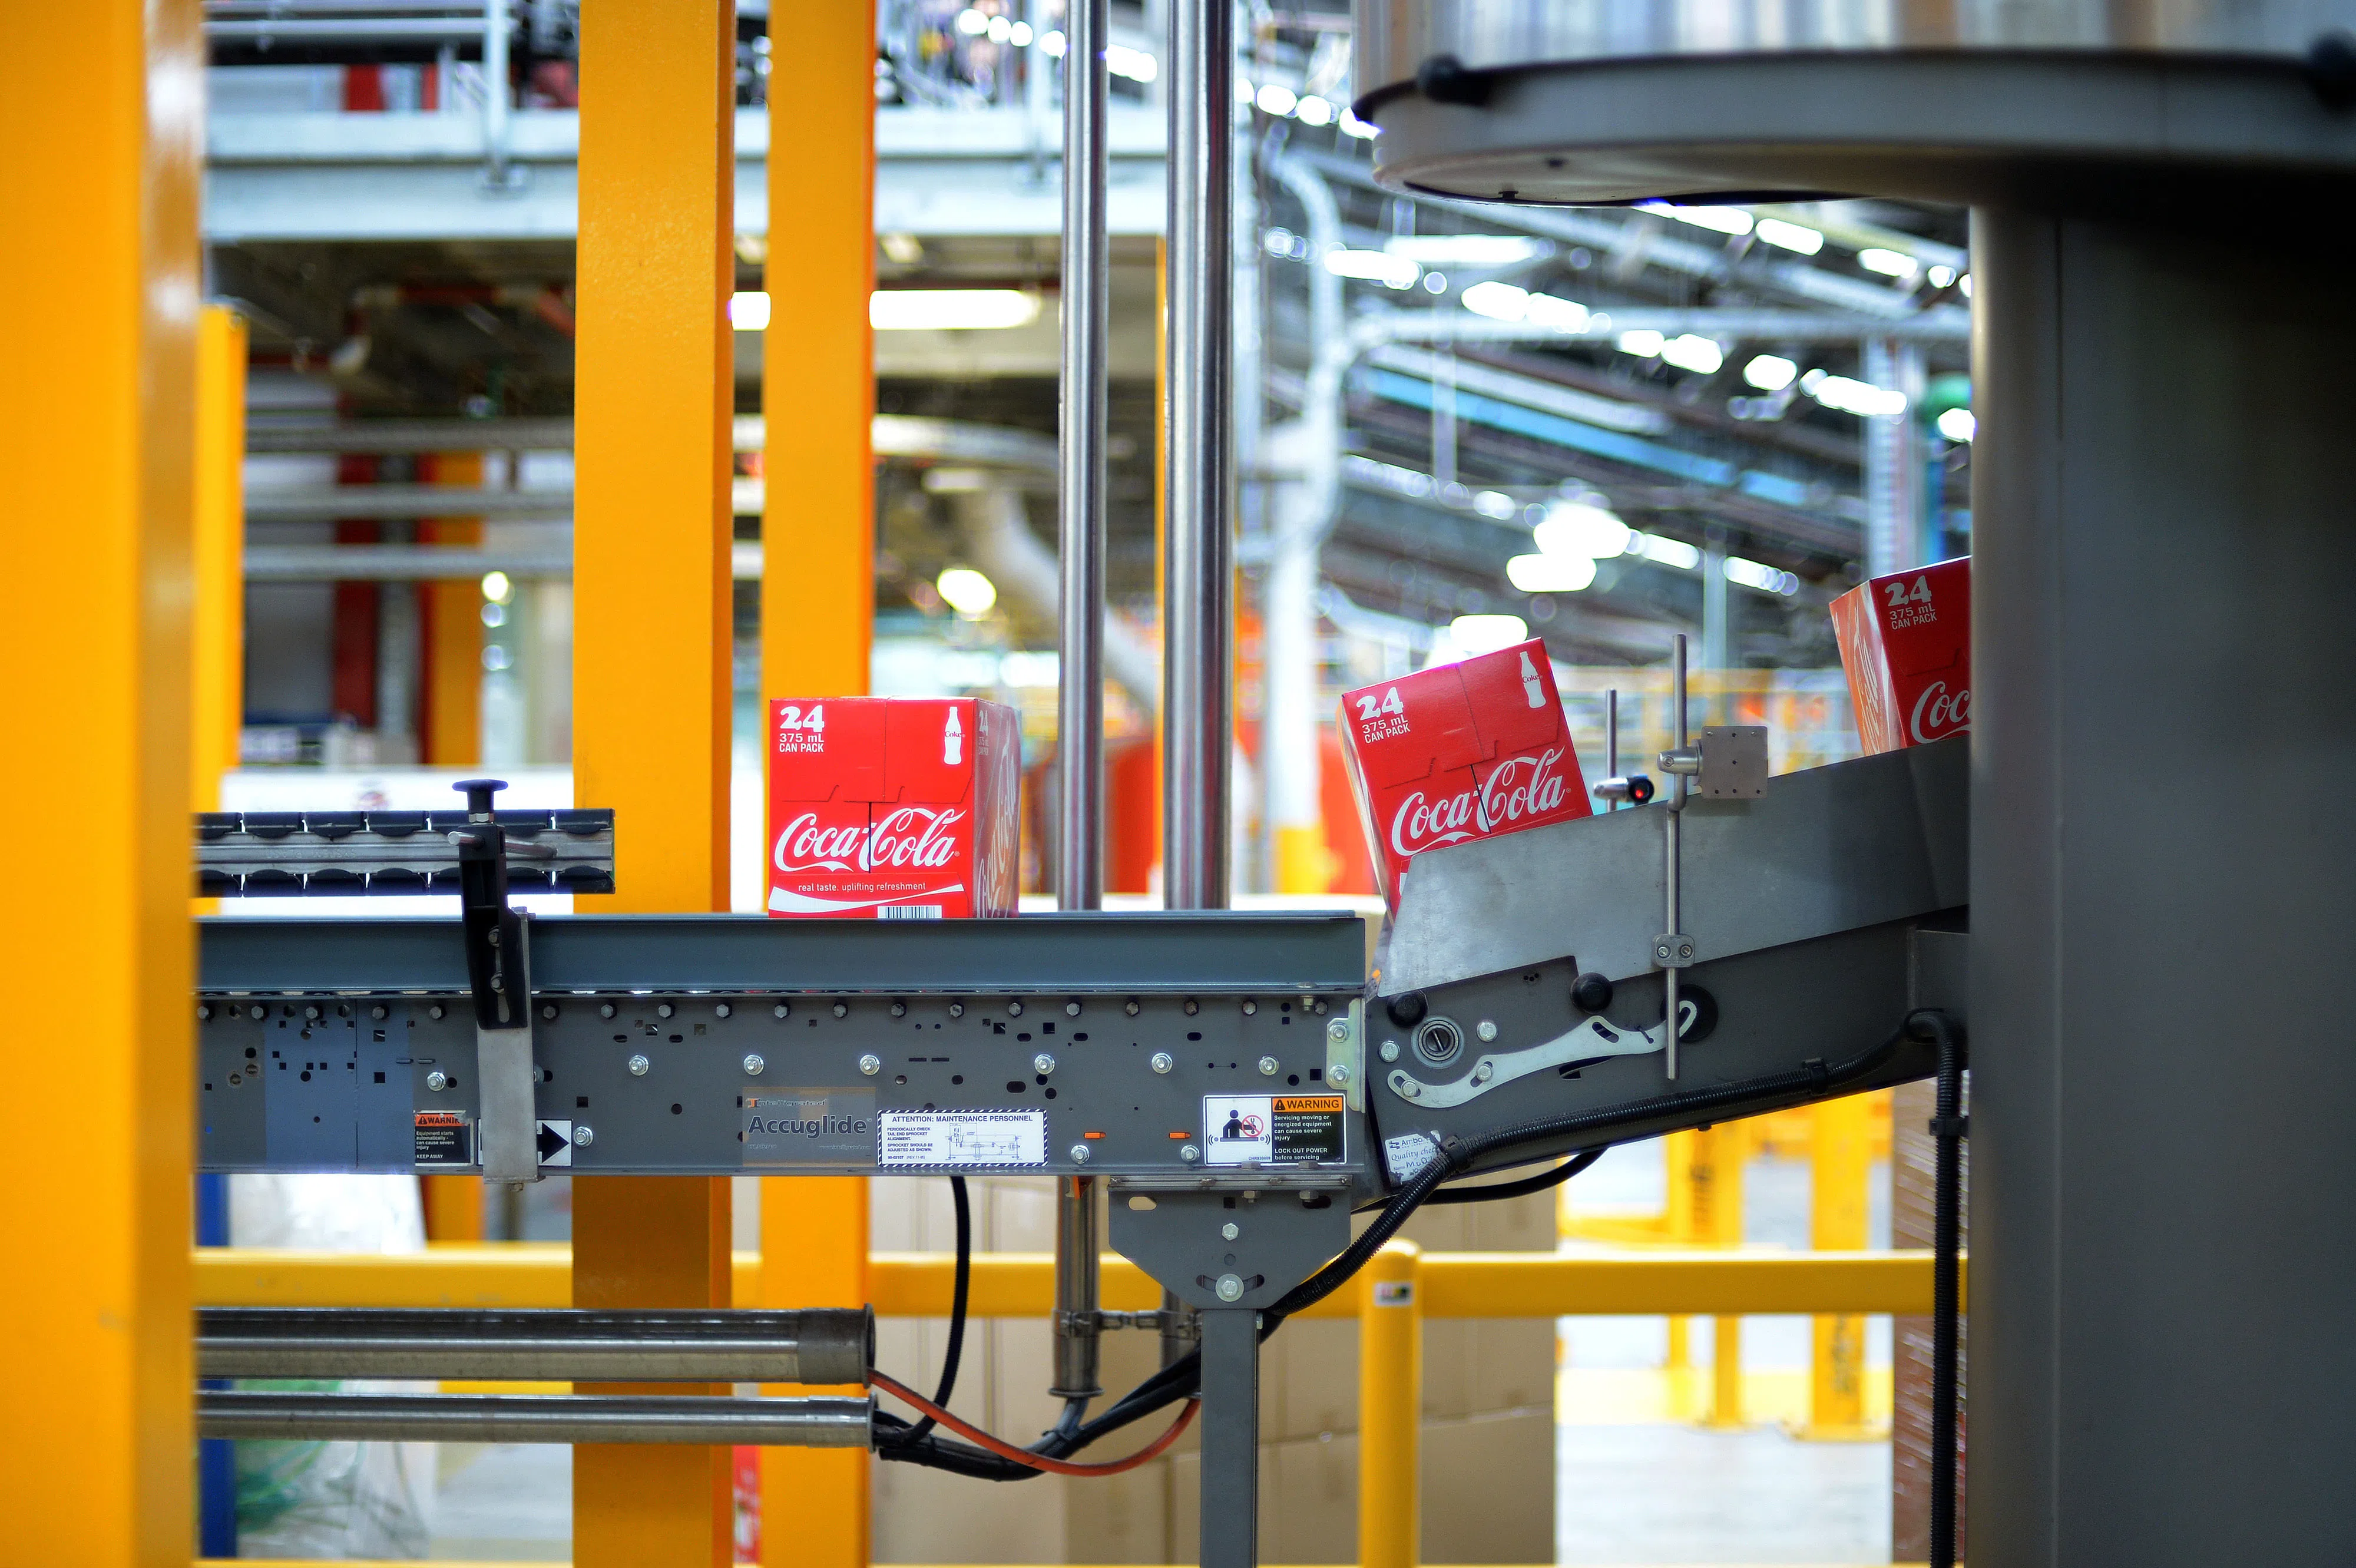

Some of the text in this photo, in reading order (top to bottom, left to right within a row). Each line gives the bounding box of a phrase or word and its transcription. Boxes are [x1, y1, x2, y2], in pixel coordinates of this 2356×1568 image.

[1885, 575, 1932, 607] 24
[1890, 603, 1935, 620] 375 mL
[1891, 612, 1937, 630] CAN PACK
[1523, 674, 1540, 683] Coke
[1356, 687, 1404, 720] 24
[1911, 681, 1970, 744] Coc
[780, 704, 825, 733] 24
[979, 710, 988, 736] 24
[1362, 714, 1408, 734] 375 mL
[779, 733, 825, 743] 375 mL
[1364, 723, 1411, 743] CAN PACK
[779, 743, 824, 753] CAN PACK
[1391, 746, 1566, 856] Coca-Cola
[775, 808, 967, 872] Coca-Cola
[798, 882, 926, 893] real taste. uplifting refreshment
[1287, 1100, 1339, 1109] WARNING
[747, 1114, 867, 1139] Accuglide
[1391, 1150, 1418, 1162] Quality
